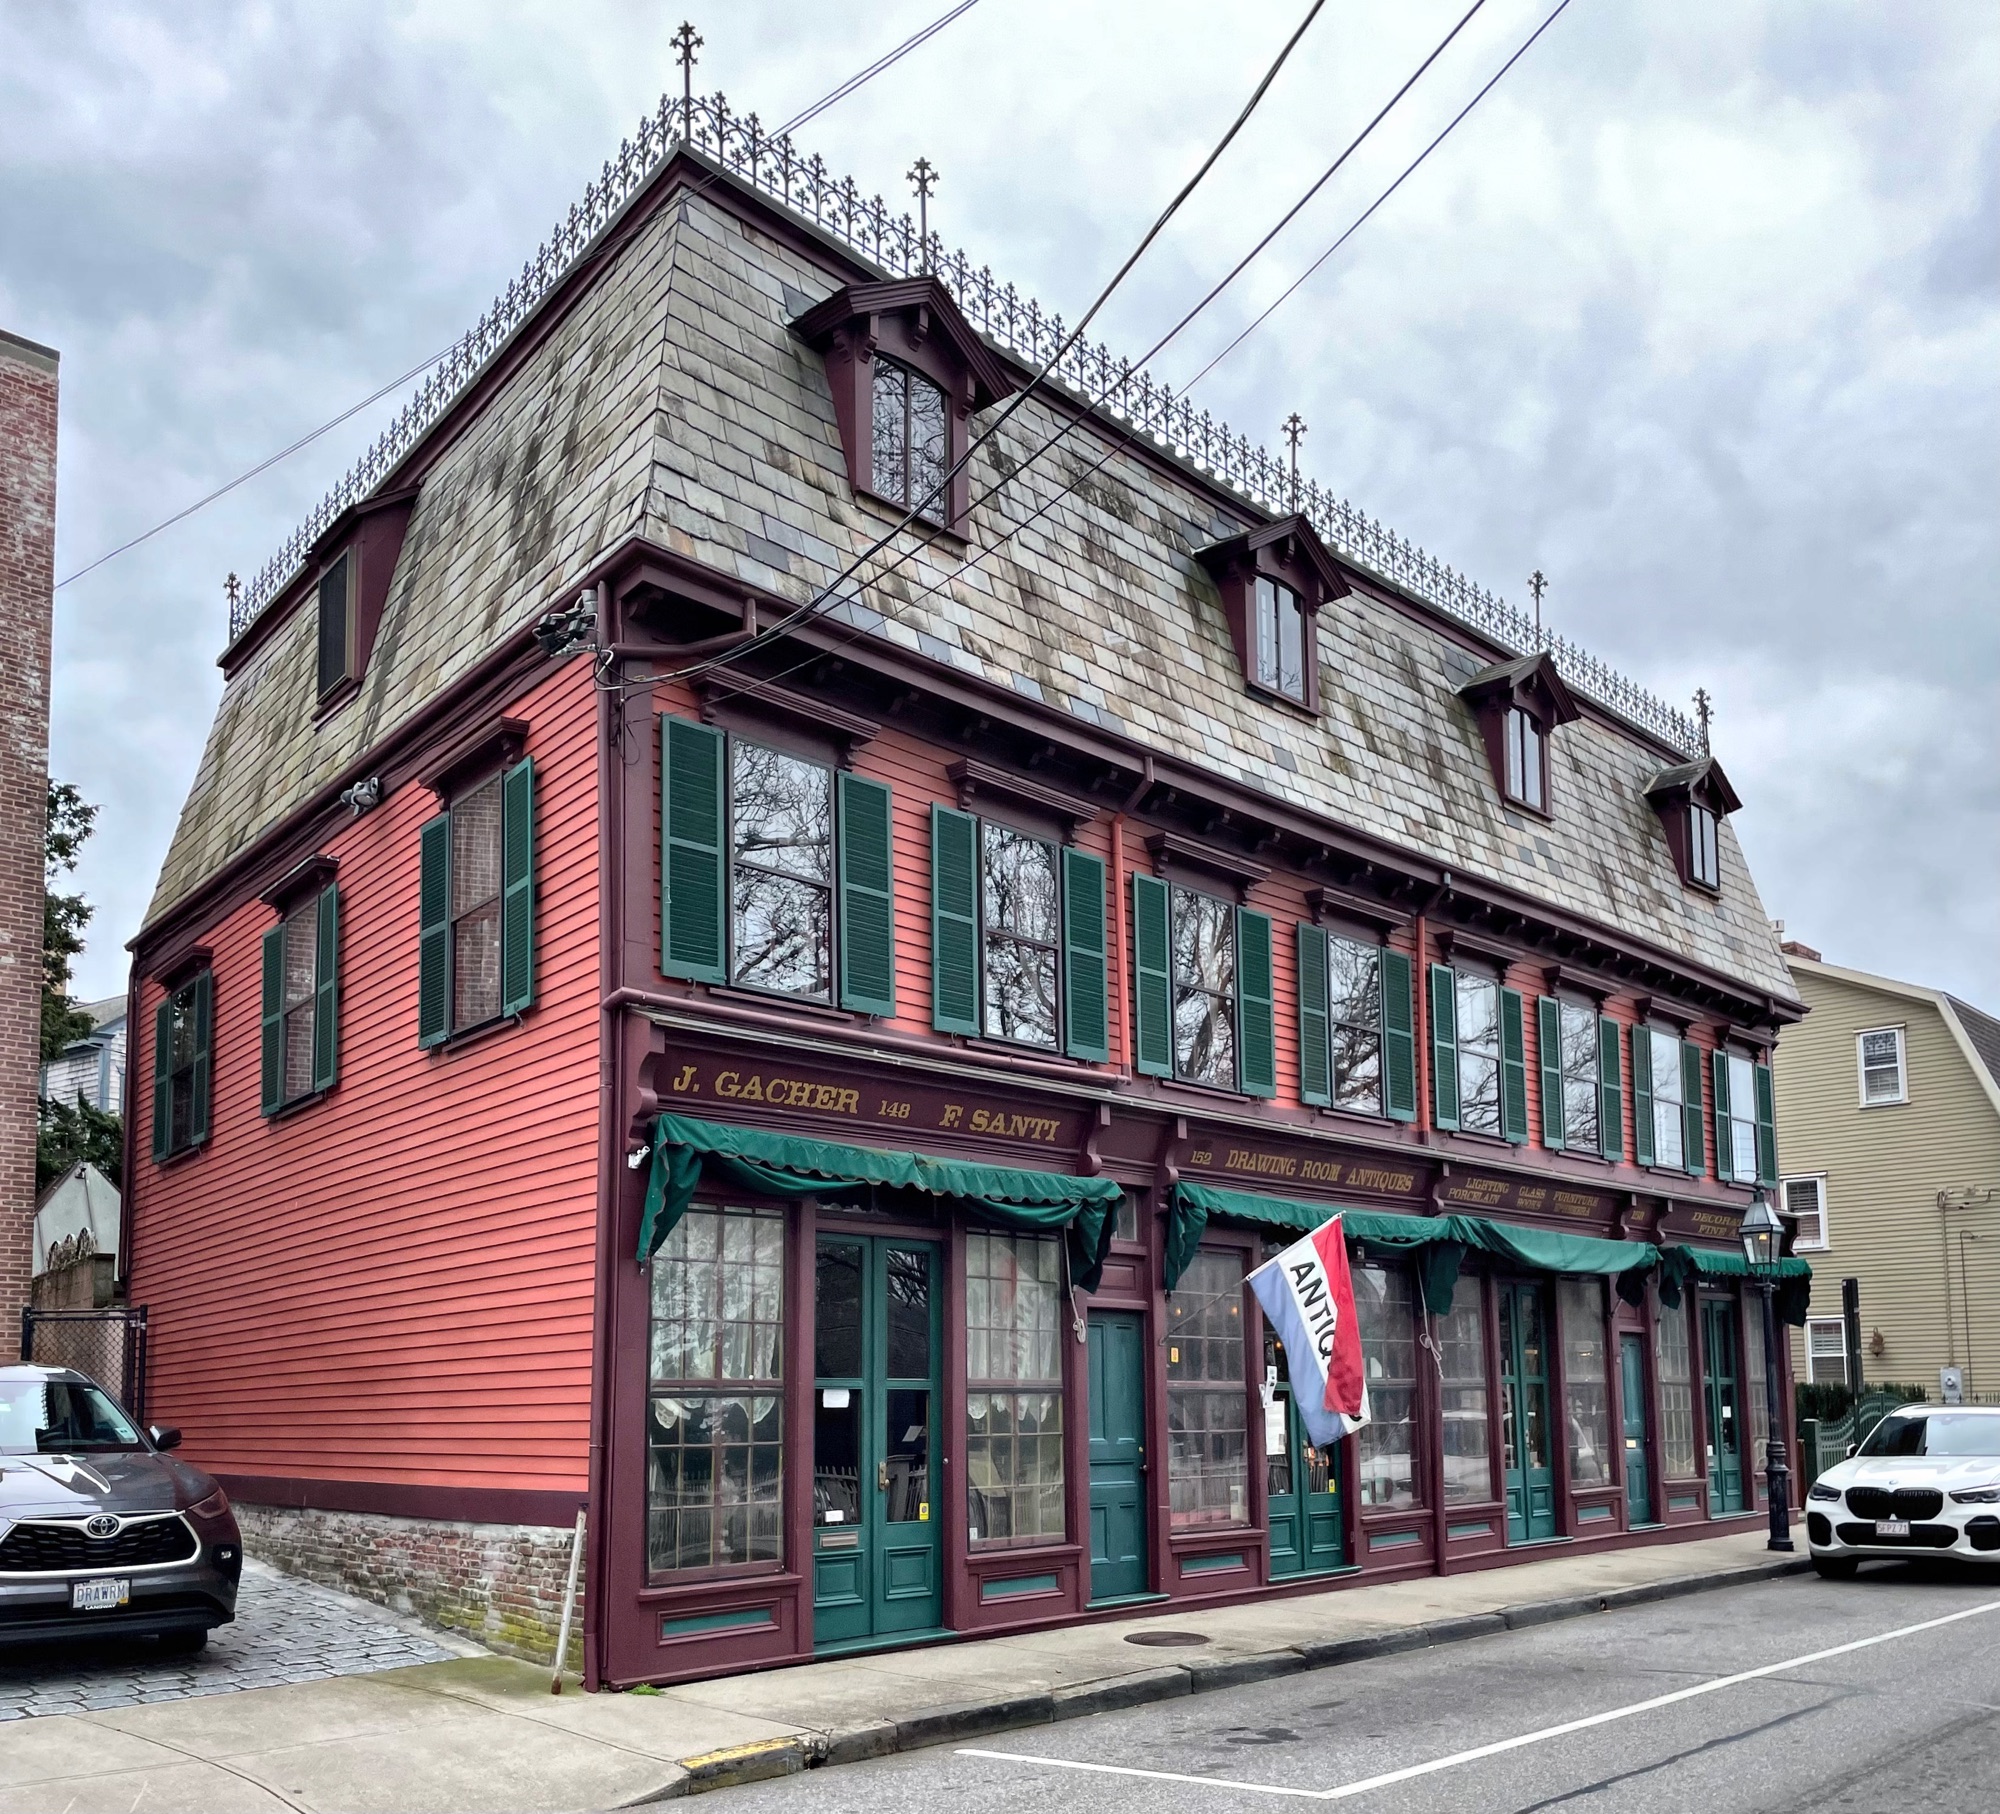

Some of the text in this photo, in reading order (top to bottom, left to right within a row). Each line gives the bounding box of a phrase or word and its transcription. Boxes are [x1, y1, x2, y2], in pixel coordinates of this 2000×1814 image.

[672, 1065, 860, 1115] J. GACHER
[878, 1099, 911, 1119] 148
[938, 1104, 1062, 1142] F. SANTI
[1190, 1150, 1212, 1166] 152
[1225, 1149, 1415, 1192] DRAWING ROOM ANTIQUES
[1447, 1187, 1501, 1204] PORCELAIN
[1465, 1177, 1601, 1207] LIGHTING GLASS FURNITURE
[1691, 1212, 1743, 1226] DECORAT
[1698, 1224, 1727, 1236] FINE
[77, 1585, 125, 1602] DRAWRM
